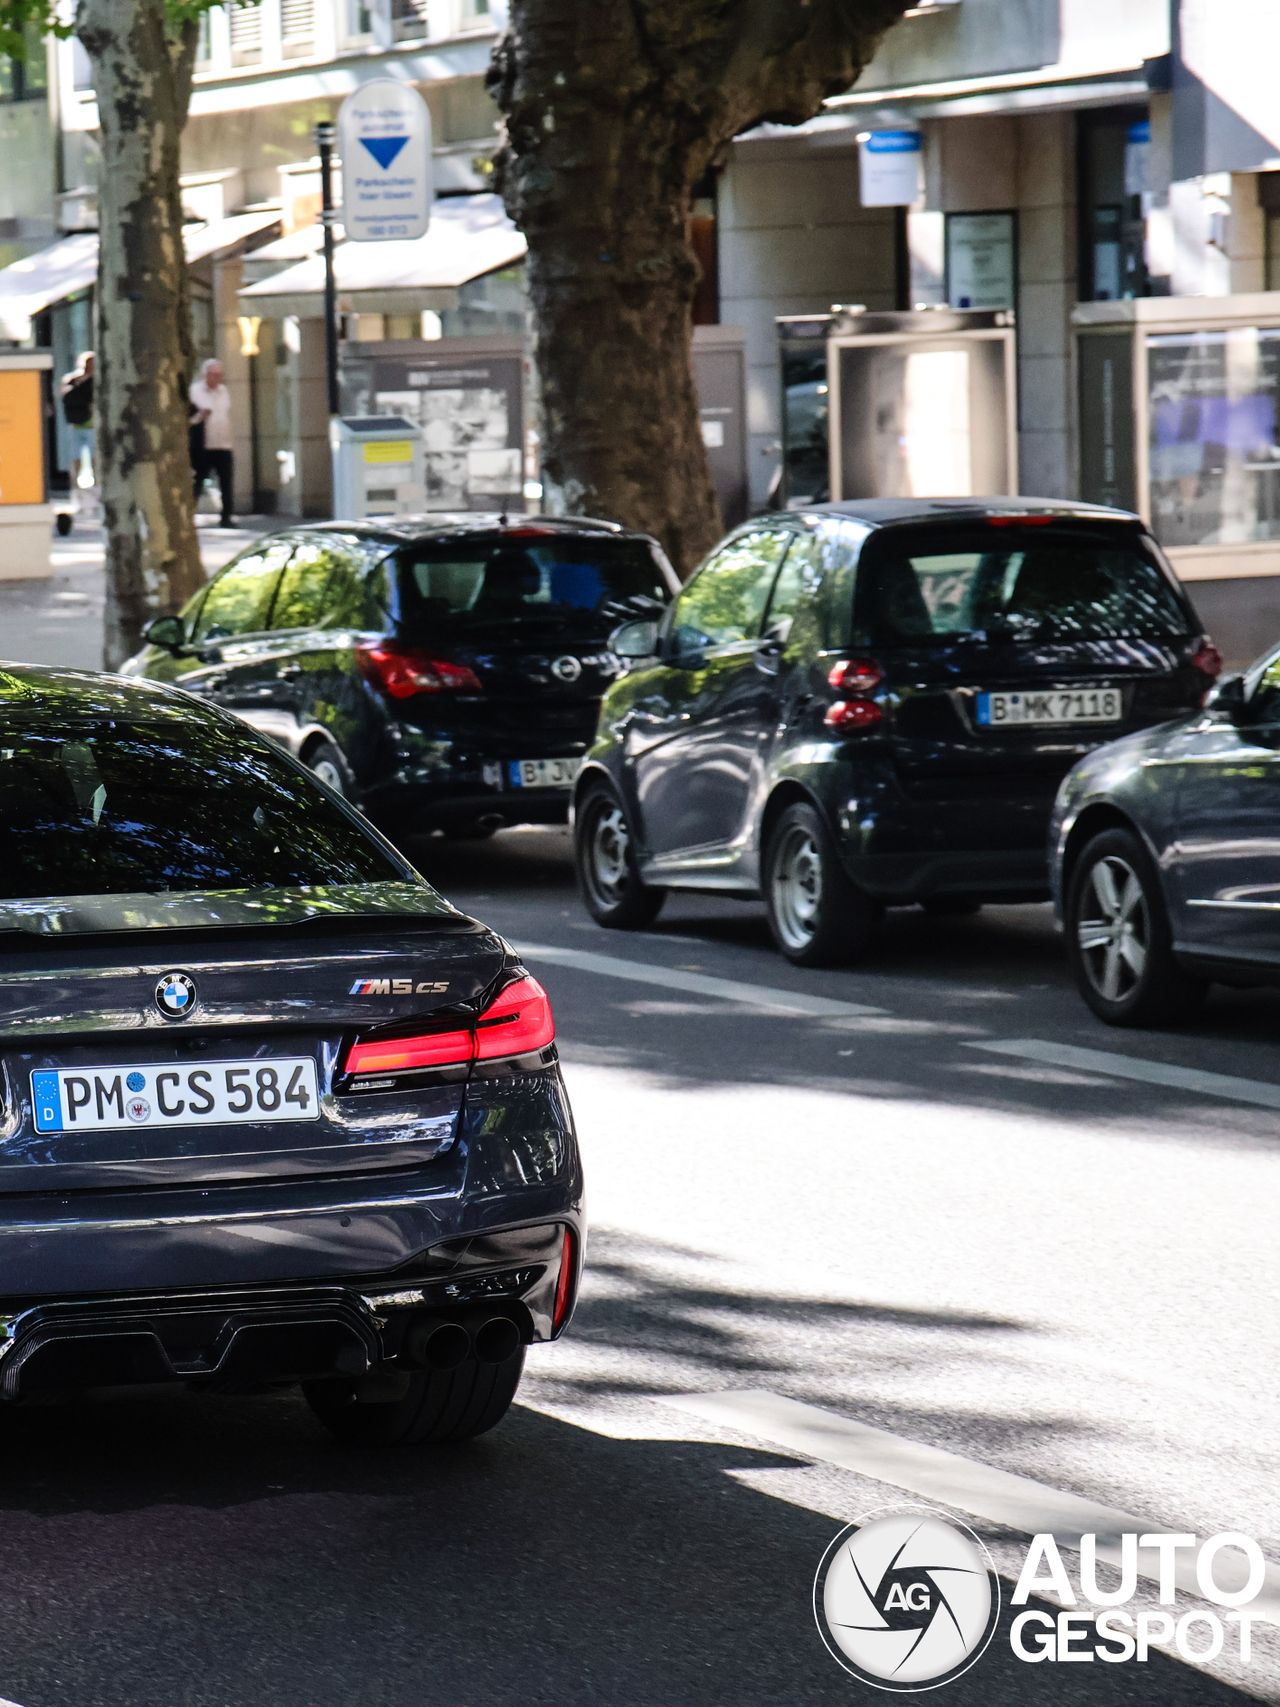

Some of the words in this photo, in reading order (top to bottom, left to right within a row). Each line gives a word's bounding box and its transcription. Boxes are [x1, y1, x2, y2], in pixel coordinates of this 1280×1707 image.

[993, 697, 1007, 720] B
[1024, 694, 1054, 718] MK
[1059, 693, 1117, 718] 7118
[524, 762, 537, 783] B
[365, 978, 413, 995] M5
[44, 1107, 55, 1121] D
[63, 1075, 125, 1122] PM
[156, 1070, 215, 1117] CS
[225, 1065, 311, 1114] 584
